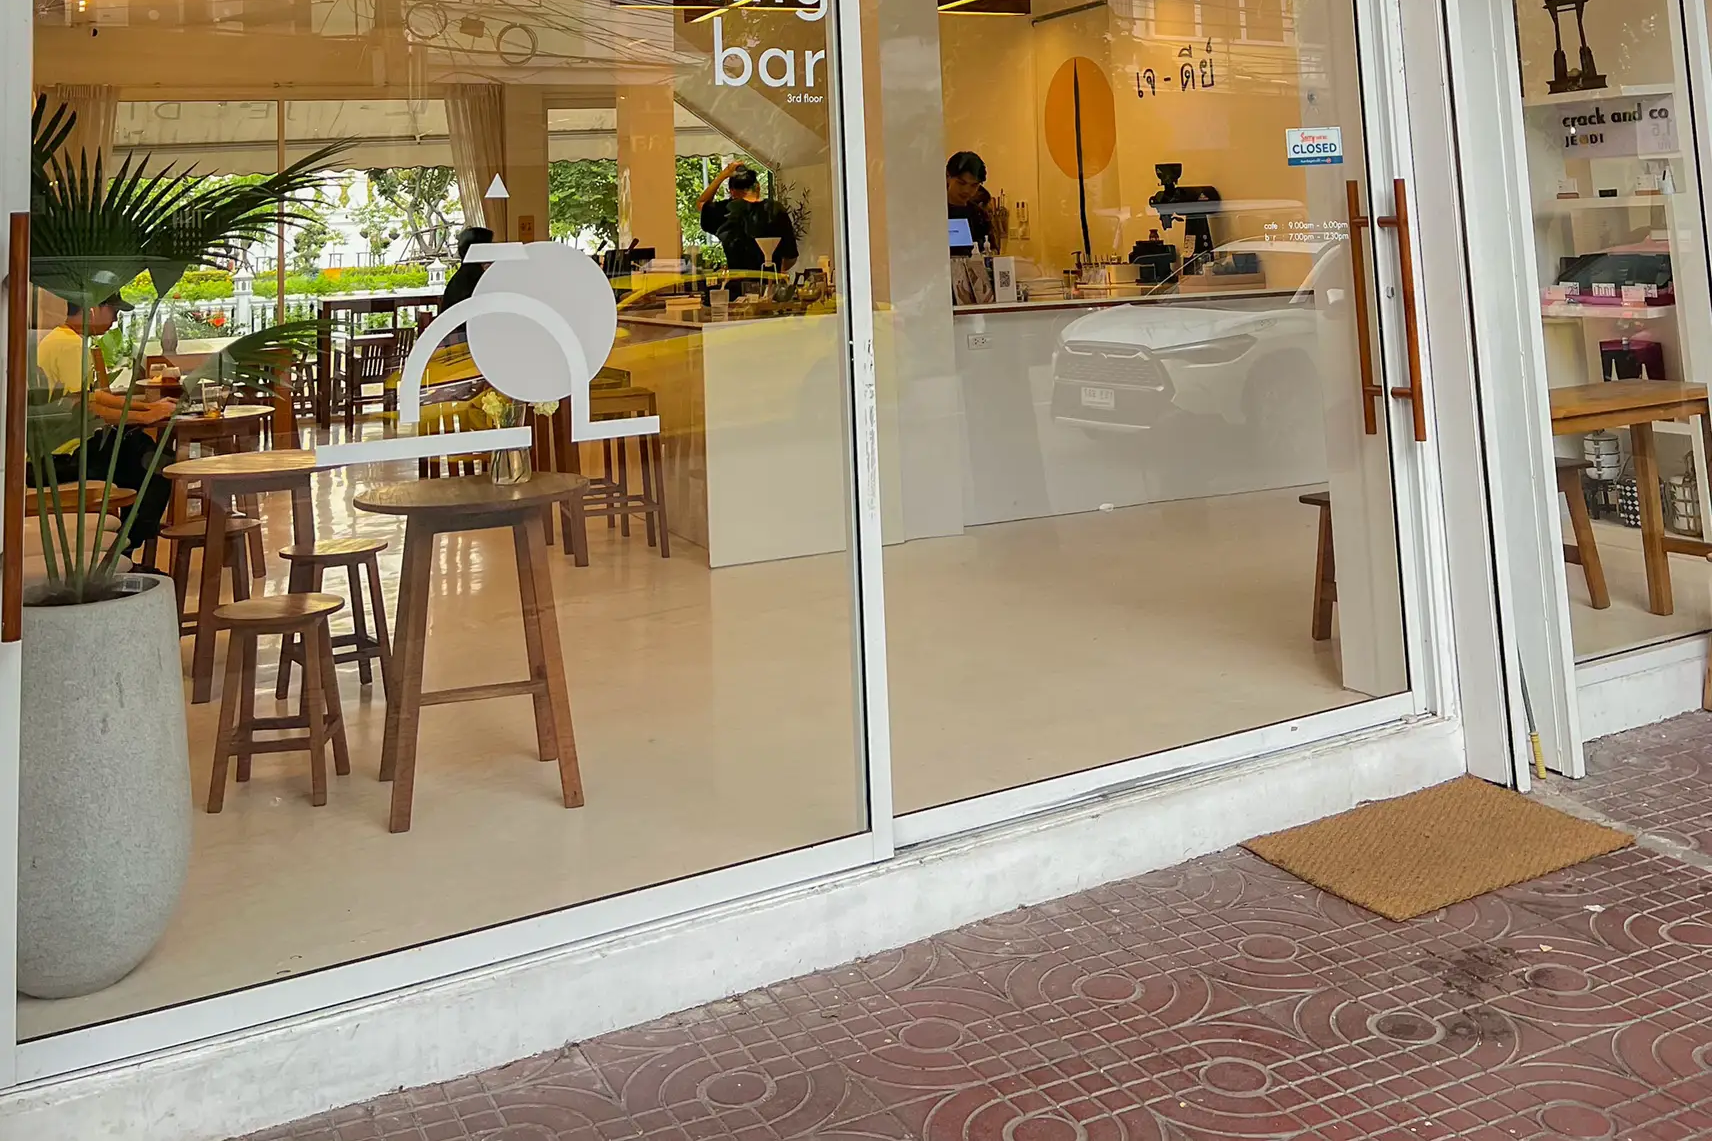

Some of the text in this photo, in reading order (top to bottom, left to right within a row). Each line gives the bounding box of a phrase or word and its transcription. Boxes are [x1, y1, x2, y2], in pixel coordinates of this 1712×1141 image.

[713, 16, 825, 87] bar
[787, 93, 824, 103] 3rd floor
[1562, 103, 1669, 127] crack and co
[1292, 143, 1337, 154] CLOSED
[1264, 221, 1278, 229] cafe
[1288, 221, 1314, 229] 9.00am
[1323, 221, 1348, 230] 6.00pm
[1264, 233, 1277, 241] br
